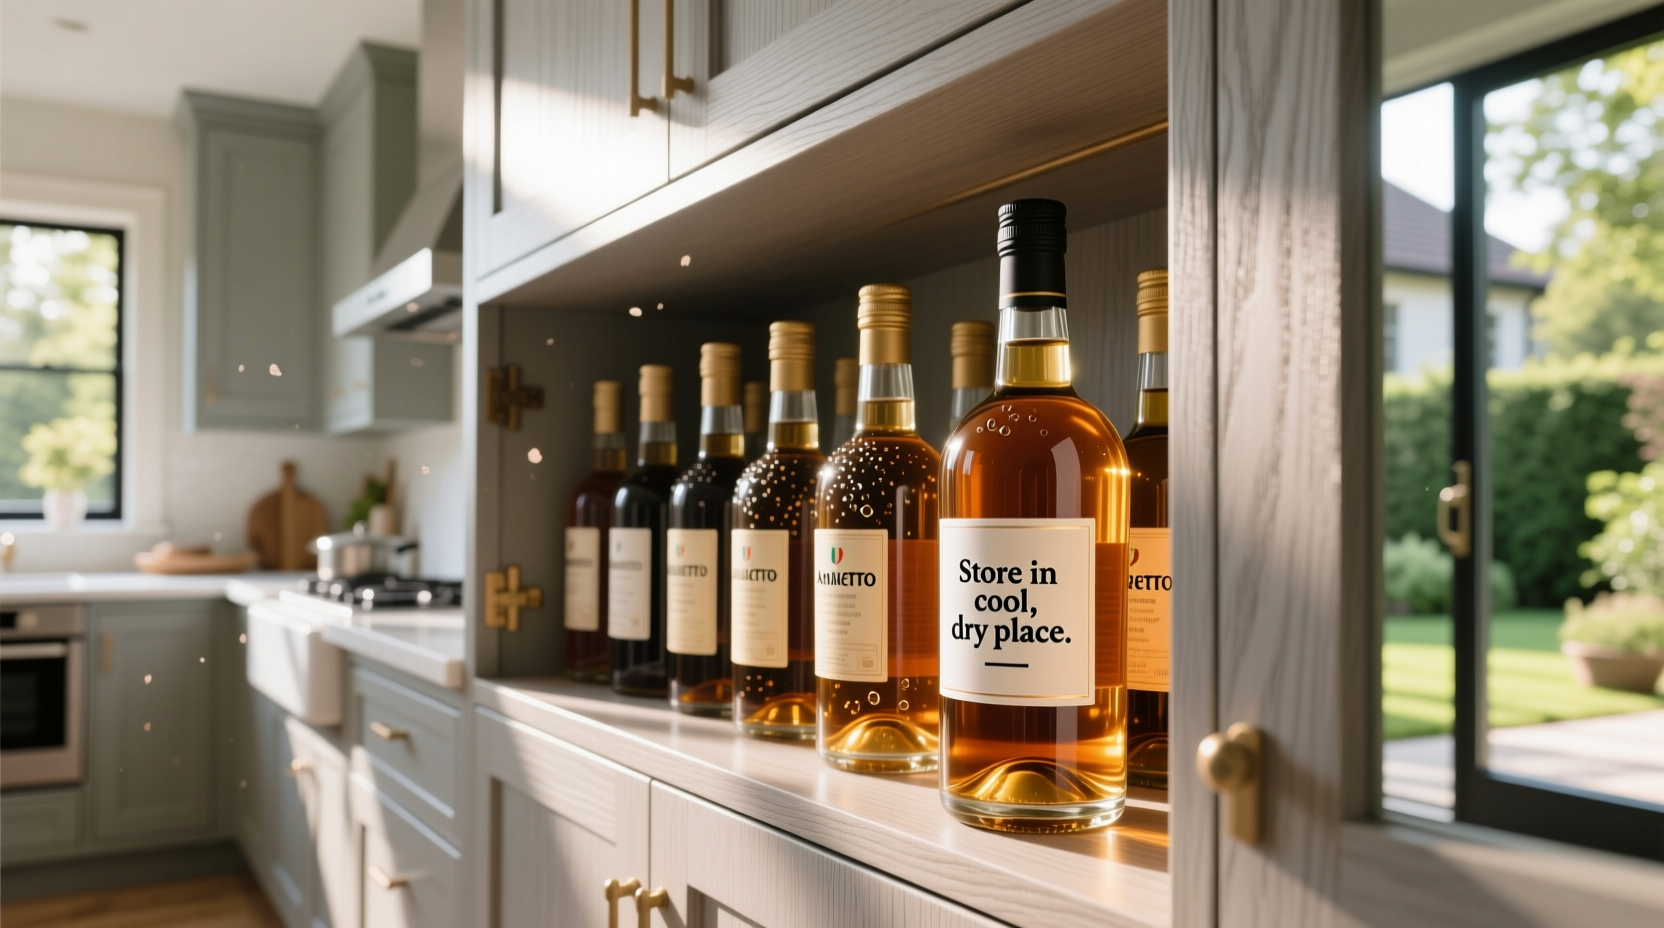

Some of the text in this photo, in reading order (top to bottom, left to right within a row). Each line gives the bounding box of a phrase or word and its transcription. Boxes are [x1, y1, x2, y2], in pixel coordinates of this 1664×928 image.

[959, 558, 1058, 585] Store in
[974, 588, 1037, 618] cool,
[951, 613, 1072, 651] dry place.
